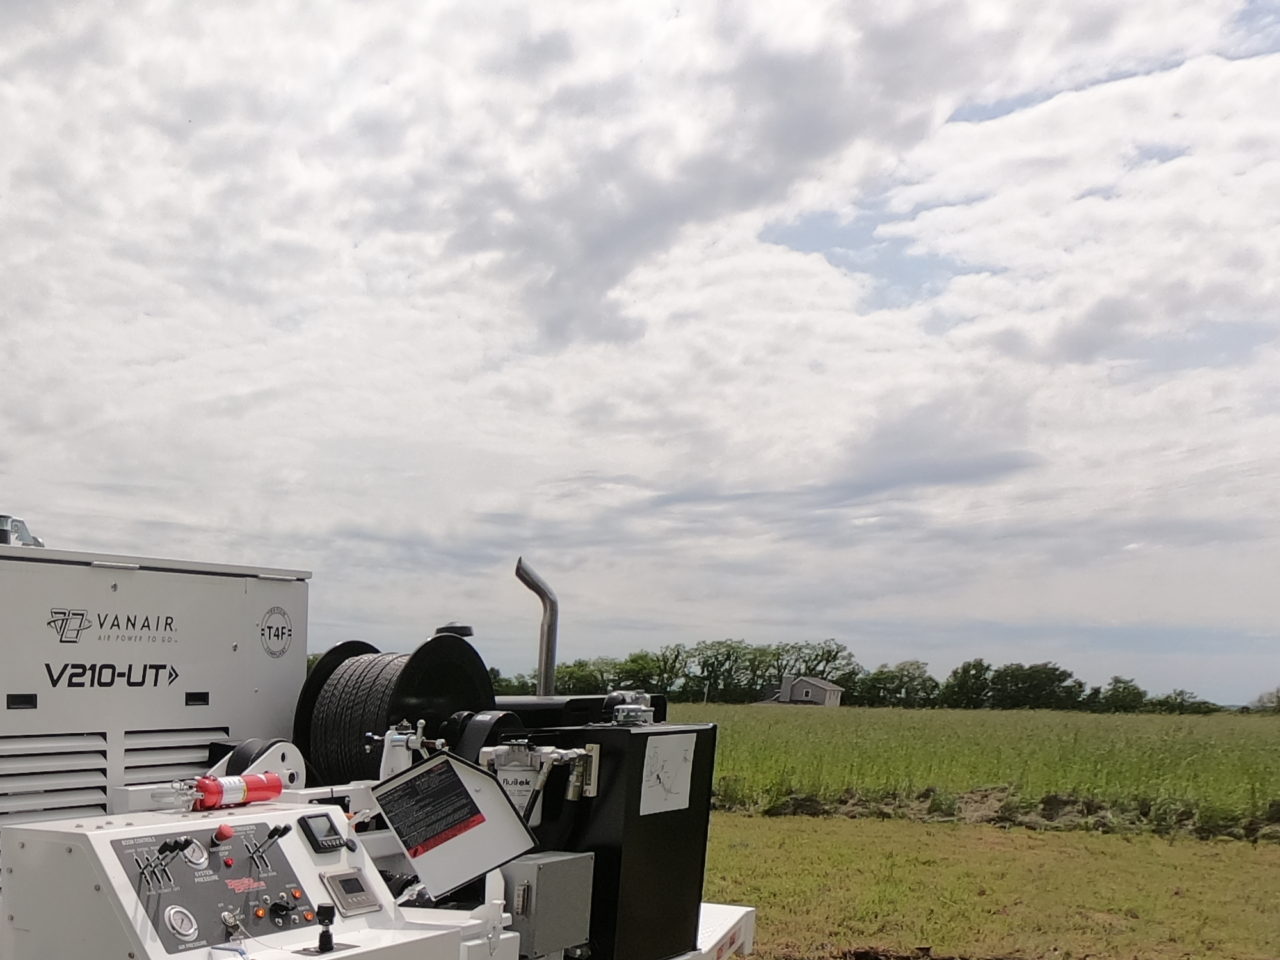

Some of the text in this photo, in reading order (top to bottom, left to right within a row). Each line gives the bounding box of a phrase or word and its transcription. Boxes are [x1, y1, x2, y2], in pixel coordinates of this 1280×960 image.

[97, 613, 174, 632] VANAIR
[267, 626, 286, 640] T4F
[44, 663, 167, 687] V210-UT
